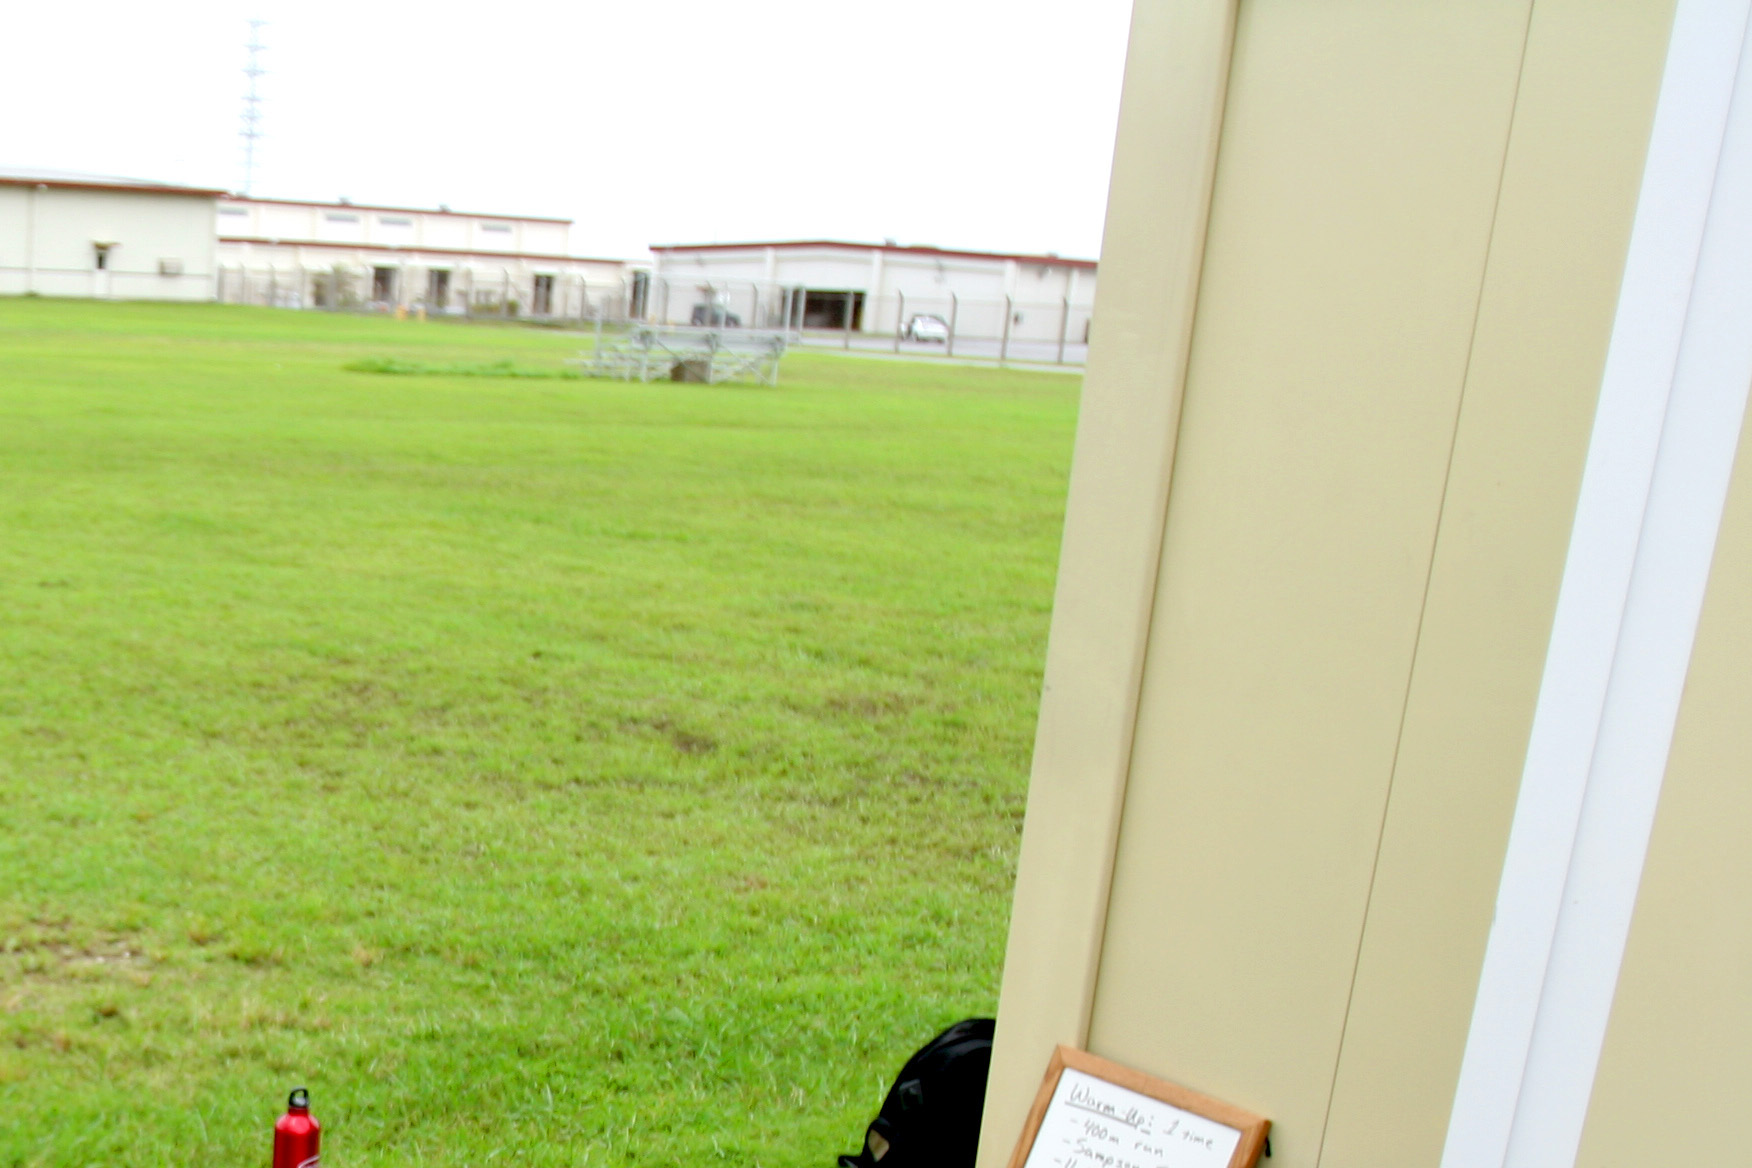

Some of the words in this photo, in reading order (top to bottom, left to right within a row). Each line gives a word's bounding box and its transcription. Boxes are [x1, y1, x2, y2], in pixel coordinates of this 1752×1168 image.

[1163, 1119, 1179, 1135] 1
[1182, 1130, 1213, 1151] time
[1134, 1141, 1163, 1156] run
